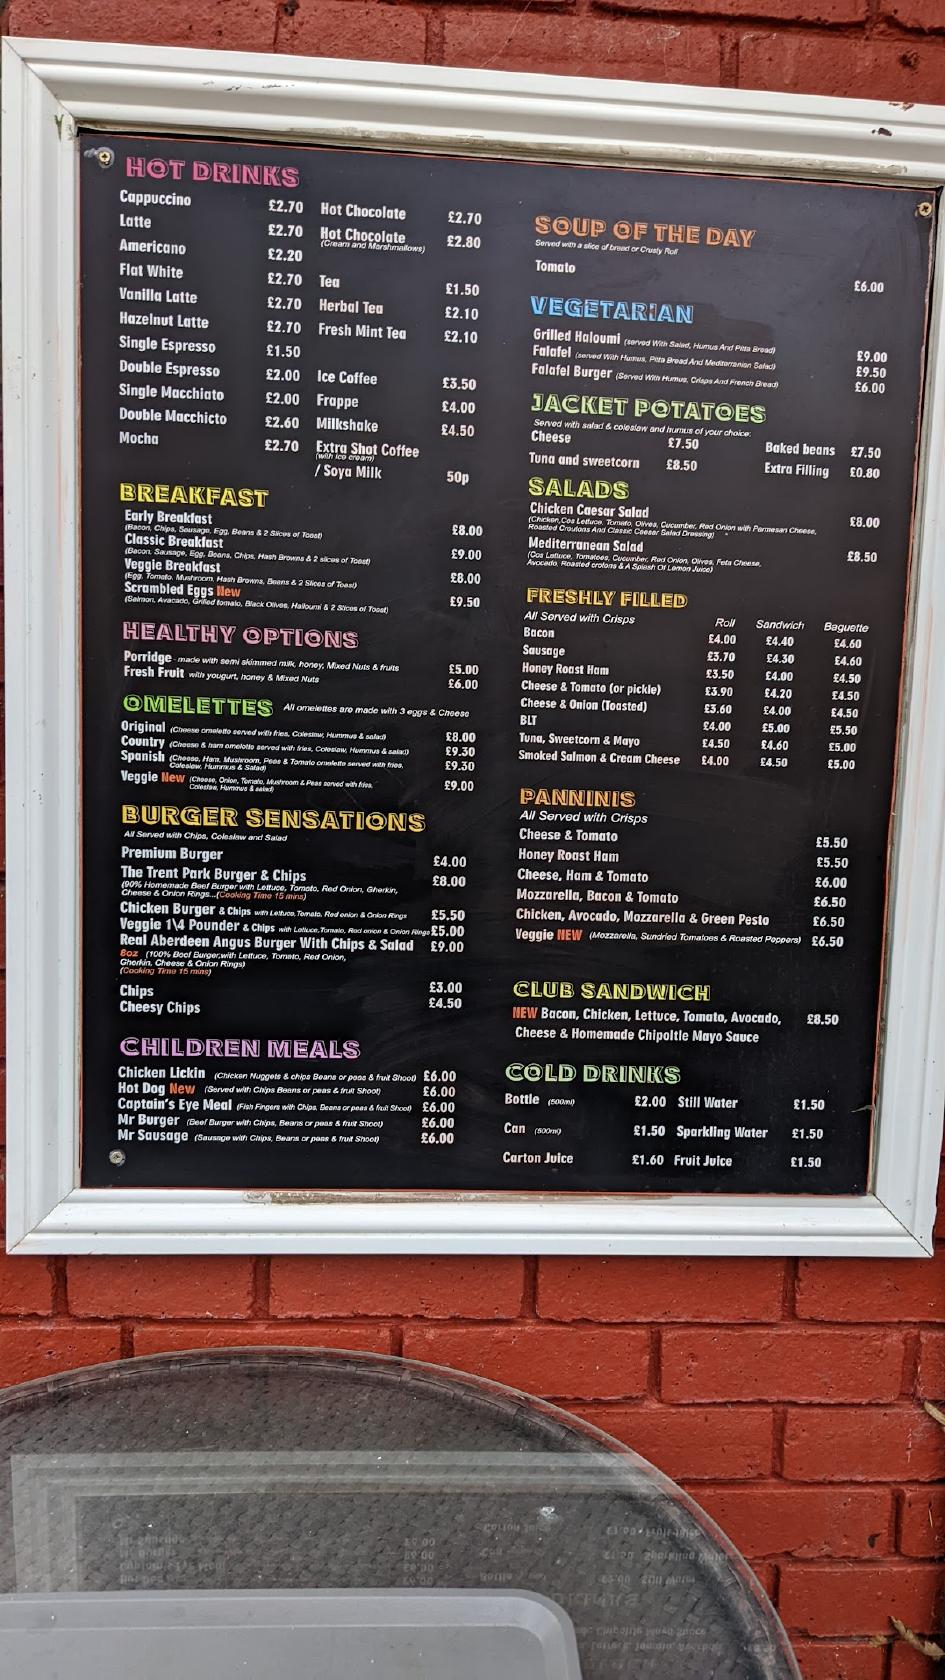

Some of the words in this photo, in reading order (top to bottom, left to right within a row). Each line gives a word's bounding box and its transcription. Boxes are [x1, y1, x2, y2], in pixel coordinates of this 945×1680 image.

[127, 157, 185, 179] HOT
[193, 161, 299, 187] DRINKS
[120, 190, 191, 206] Cappuccino
[269, 199, 303, 213] £2.70
[321, 202, 342, 215] Hot
[346, 204, 406, 220] Chocolate
[120, 214, 151, 228] Latte
[448, 211, 481, 224] £2.70
[269, 224, 303, 237] £2.70
[535, 216, 606, 237] SOUP
[613, 221, 647, 240] OF
[654, 224, 700, 243] THE
[707, 228, 756, 247] DAY
[120, 263, 143, 276] Flat
[147, 265, 183, 279] White
[536, 260, 575, 273] Tomato
[268, 272, 302, 286] £2.70
[854, 280, 884, 292] £6.00
[320, 299, 358, 313] Herbal
[363, 302, 383, 314] Tea
[445, 306, 478, 320] £2.10
[531, 296, 693, 323] VEGETARIAN
[120, 312, 173, 326] Hazelnut
[178, 315, 209, 328] Latte
[267, 320, 301, 334] £2.70
[319, 323, 351, 336] Fresh
[356, 325, 383, 338] Mint
[387, 327, 406, 339] Tea
[444, 330, 477, 343] £2.10
[534, 328, 571, 341] Grilled
[575, 331, 620, 344] Haloumi
[857, 351, 887, 362] £9.00
[532, 363, 570, 376] Falafel
[574, 365, 612, 380] Burger
[855, 382, 885, 393] £6.00
[120, 407, 161, 421] Double
[165, 410, 227, 424] Macchicto
[531, 394, 628, 415] JACKET
[635, 399, 766, 423] POTATOES
[265, 416, 299, 428] £2.60
[317, 417, 378, 432] Milkshake
[442, 424, 474, 437] £4.50
[531, 430, 571, 443] Cheese
[668, 437, 699, 449] £7.50
[766, 442, 799, 454] Baked
[803, 444, 835, 456] beans
[851, 447, 881, 458] £7.50
[324, 464, 351, 479] Soya
[356, 466, 381, 479] Milk
[447, 471, 469, 485] 50p
[120, 483, 269, 507] BREAKFAST
[529, 477, 629, 499] SALADS
[125, 510, 154, 524] Early
[157, 511, 212, 524] Breakfast
[530, 502, 573, 514] Chicken
[577, 504, 615, 516] Caesar
[618, 506, 649, 518] Salad
[850, 517, 880, 528] £8.00
[452, 525, 483, 536] £8.00
[125, 581, 183, 595] Scrambled
[188, 584, 213, 599] Eggs
[217, 586, 240, 597] New
[450, 596, 480, 607] £9.50
[527, 588, 615, 605] FRESHLY
[621, 592, 687, 608] FILLED
[524, 611, 538, 620] All
[540, 612, 577, 621] Served
[580, 614, 599, 622] with
[603, 614, 635, 625] Crisps
[524, 627, 554, 638] Bacon
[715, 618, 735, 627] Roll
[756, 620, 804, 629] Sandwich
[824, 622, 869, 633] Baguette
[123, 622, 236, 643] HEALTHY
[243, 627, 358, 648] OPTIONS
[709, 634, 736, 644] £4.00
[766, 636, 794, 646] £4.40
[834, 639, 861, 648] £4.60
[124, 665, 154, 677] Fresh
[158, 667, 184, 678] Fruit
[241, 674, 265, 682] honey
[449, 679, 478, 689] £6.00
[123, 695, 273, 717] OMELETTES
[283, 703, 295, 711] All
[439, 709, 469, 717] Cheese
[121, 720, 165, 734] Original
[446, 732, 476, 742] £8.00
[521, 788, 635, 807] PANNINIS
[122, 805, 238, 826] BURGER
[246, 808, 425, 832] SENSATIONS
[519, 828, 561, 840] Cheese
[565, 830, 572, 840] &
[576, 829, 618, 841] Tomato
[816, 837, 848, 848] £5.50
[122, 846, 176, 858] Premium
[180, 847, 223, 862] Burger
[434, 856, 466, 867] £4.00
[516, 928, 554, 942] Veggie
[557, 929, 582, 940] NEW
[812, 936, 843, 947] £6.50
[514, 981, 574, 998] CLUB
[581, 983, 710, 1001] SANDWICH
[120, 1000, 163, 1015] Cheesy
[167, 1001, 200, 1015] Chips
[429, 997, 462, 1008] £4.50
[513, 1007, 538, 1018] NEW
[541, 1007, 579, 1020] Bacon,
[583, 1008, 631, 1021] Chicken,
[635, 1010, 680, 1022] Lettuce,
[683, 1010, 727, 1023] Tomato,
[731, 1012, 781, 1025] Avocado,
[807, 1014, 839, 1025] £8.50
[120, 1037, 260, 1057] CHILDREN
[268, 1040, 360, 1059] MEALS
[118, 1066, 165, 1078] Chicken
[170, 1067, 205, 1078] Lickin
[424, 1070, 456, 1082] £6.00
[505, 1063, 576, 1081] COLD
[583, 1065, 680, 1084] DRINKS
[505, 1093, 539, 1104] Bottle
[635, 1096, 666, 1107] £2.00
[678, 1096, 700, 1107] Still
[704, 1097, 738, 1108] Water
[794, 1099, 824, 1110] £1.50
[674, 1155, 700, 1166] Fruit
[703, 1155, 732, 1166] Juice
[791, 1157, 821, 1167] £1.50
